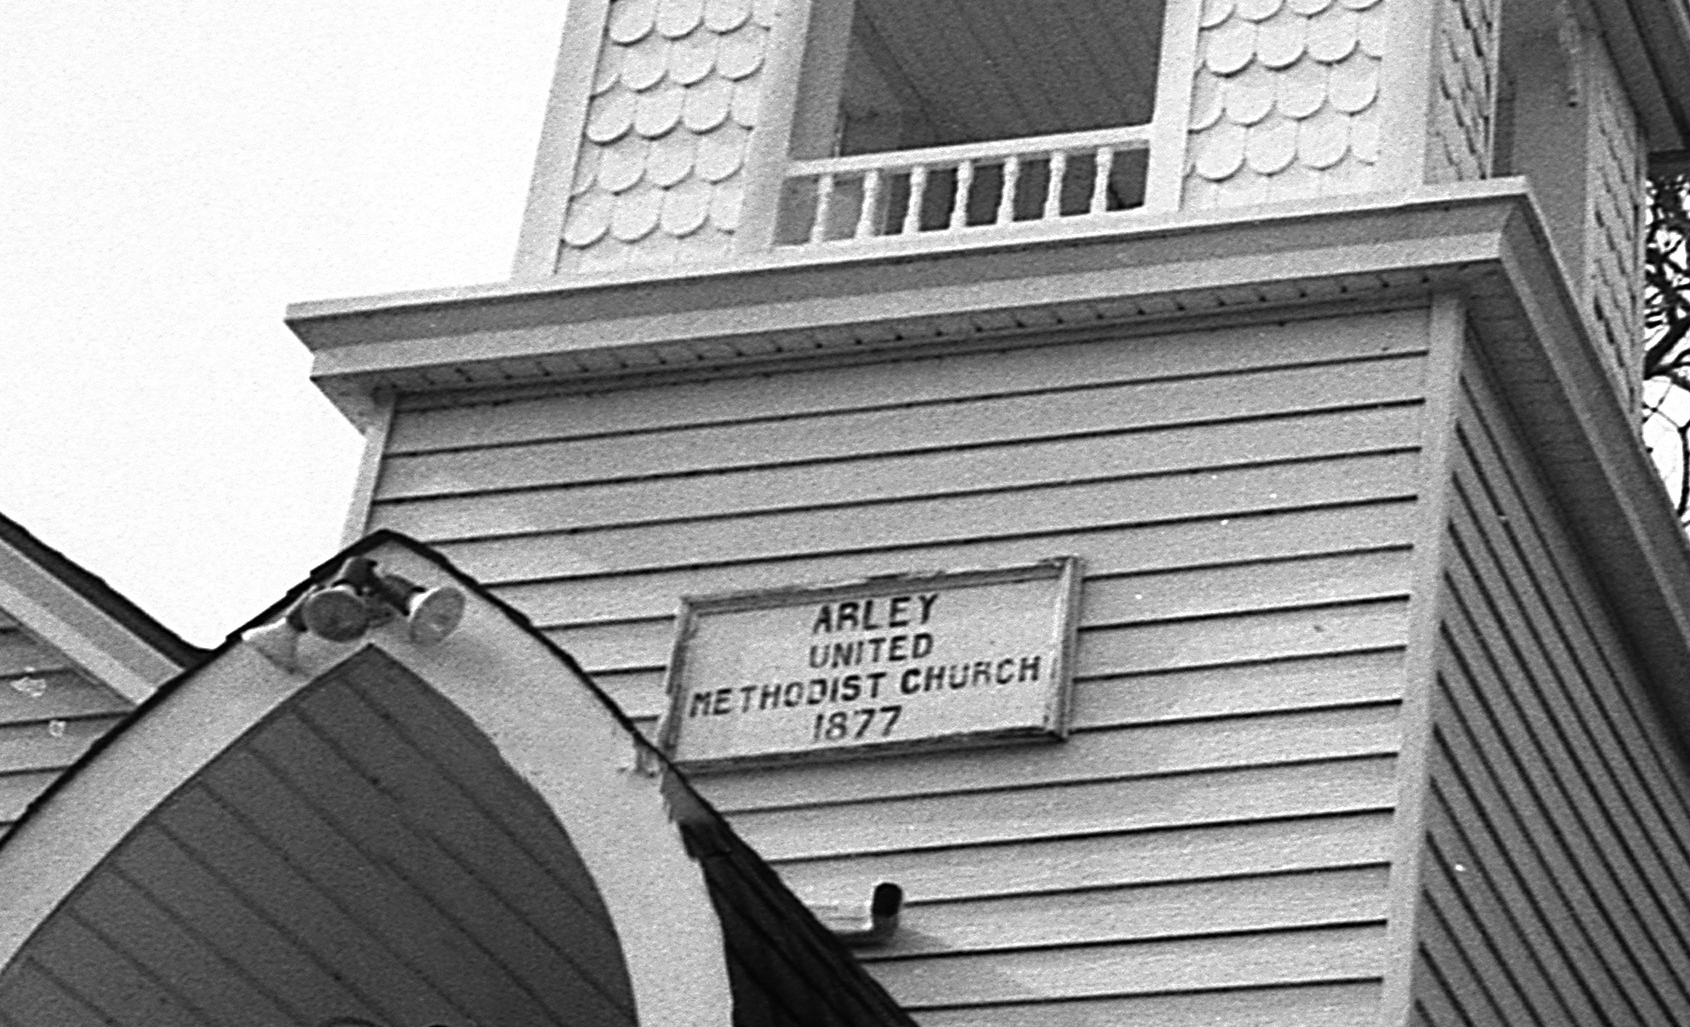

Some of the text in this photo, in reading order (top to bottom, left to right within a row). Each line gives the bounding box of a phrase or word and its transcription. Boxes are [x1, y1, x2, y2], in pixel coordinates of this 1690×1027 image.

[812, 593, 939, 634] ARLEY
[808, 632, 935, 670] UNITED
[688, 655, 1042, 719] METHODIST CHURCH
[811, 705, 903, 741] 1877
